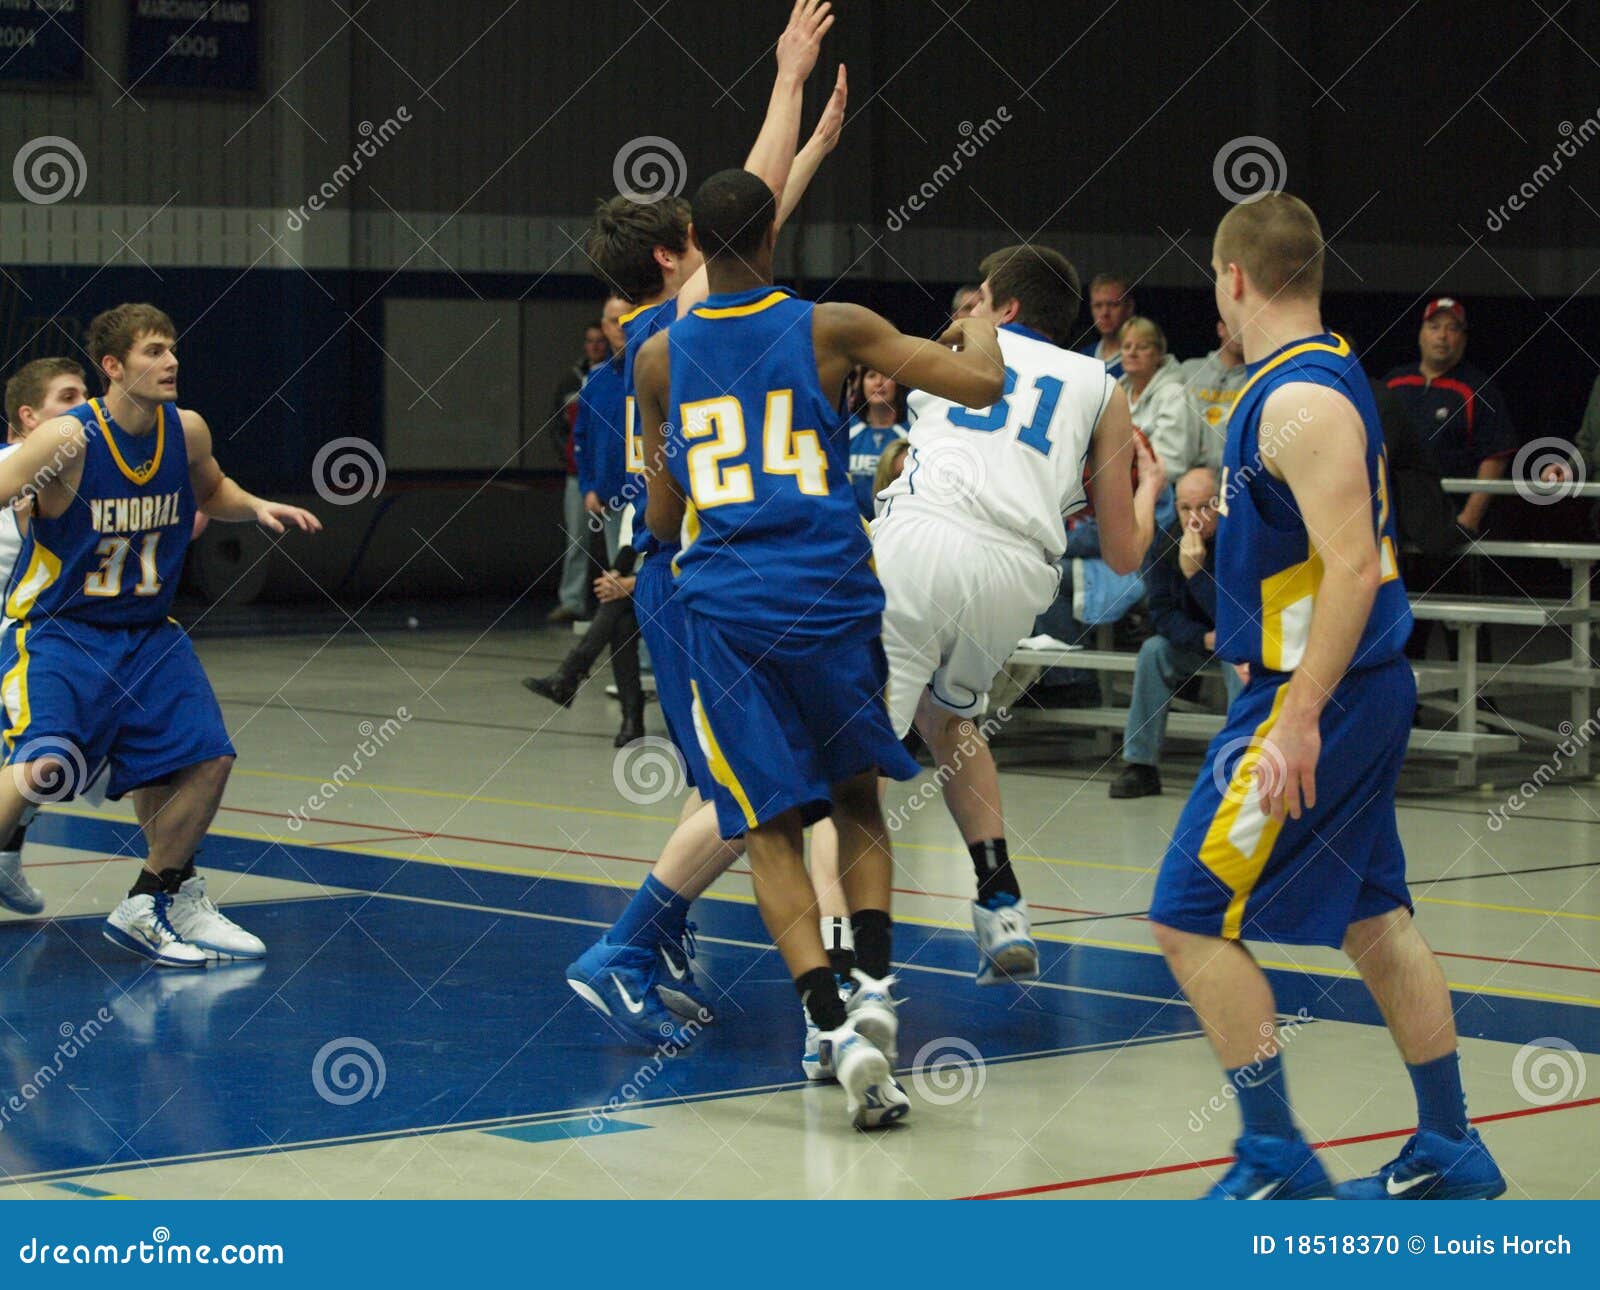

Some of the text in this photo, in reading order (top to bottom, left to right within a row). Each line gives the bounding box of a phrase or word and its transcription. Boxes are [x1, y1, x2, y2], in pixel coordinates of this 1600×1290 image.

[212, 2, 250, 23] BAND
[169, 34, 219, 58] 2005
[680, 389, 830, 510] 24
[89, 492, 180, 534] MEMORIAL
[83, 531, 162, 597] 31
